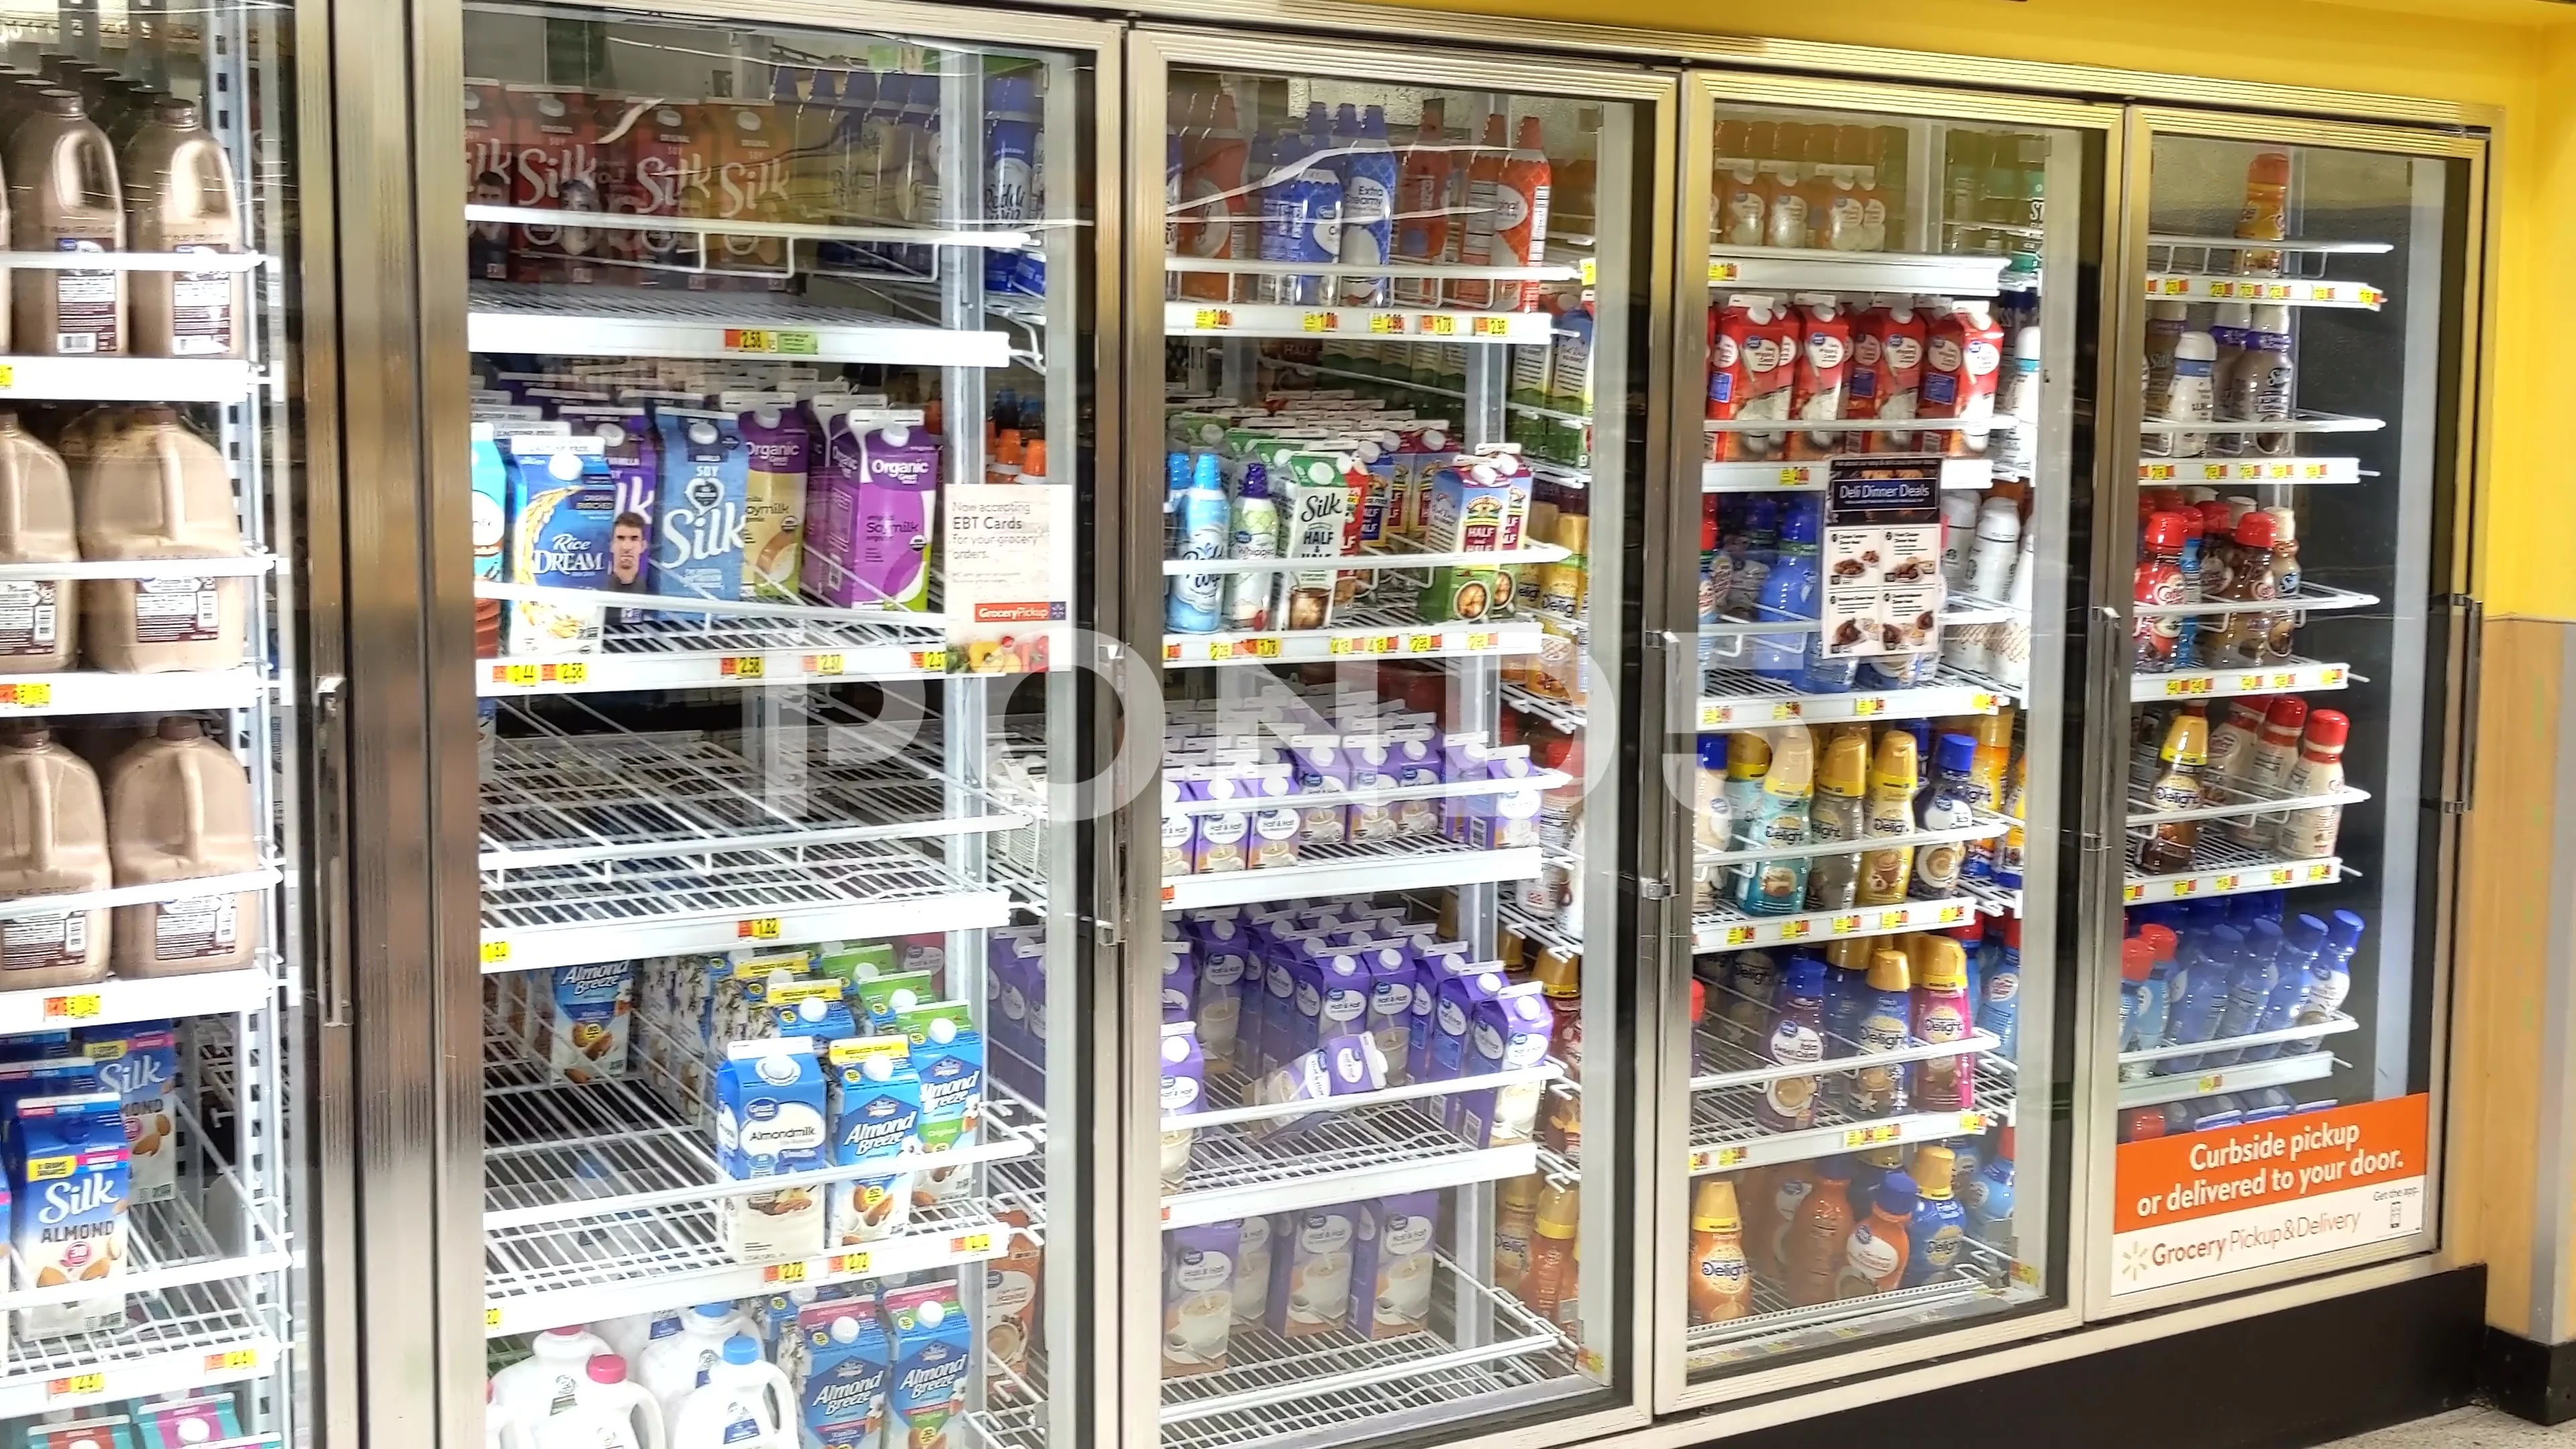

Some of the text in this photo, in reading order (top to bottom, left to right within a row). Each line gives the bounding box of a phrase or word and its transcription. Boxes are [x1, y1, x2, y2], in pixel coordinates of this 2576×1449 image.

[519, 144, 597, 206] Silk
[636, 154, 710, 214] Silk
[719, 158, 790, 218] Silk
[696, 466, 719, 476] SOY
[871, 458, 929, 478] Organic
[1839, 483, 1930, 498] Deli Dinner Deals
[745, 504, 790, 516] oymilk
[1301, 492, 1342, 523] Silk
[661, 502, 747, 569] Silk
[953, 516, 1023, 530] EBT Cards
[1467, 527, 1495, 537] HALF
[551, 533, 592, 553] Rice
[1303, 531, 1334, 545] HALF
[532, 549, 603, 576] DREAM
[561, 959, 631, 986] Almond
[574, 974, 620, 996] Breeze
[97, 1054, 168, 1095] Silk
[918, 1069, 981, 1104] Almond
[922, 1089, 969, 1115] Breeze
[749, 1125, 817, 1142] Almondmilk
[843, 1110, 918, 1146] Almond
[855, 1130, 905, 1156] Breeze
[2189, 1122, 2361, 1171] Curbside pickup
[2137, 1148, 2404, 1218] or delivered to your door.
[38, 1171, 121, 1225] Silk
[40, 1219, 115, 1244] ALMOND
[2151, 1234, 2227, 1267] Grocery
[2229, 1224, 2282, 1252] Pickup
[2298, 1210, 2361, 1238] Delivery
[899, 1352, 968, 1391] Almond
[812, 1370, 885, 1407] Almond
[910, 1373, 956, 1400] Breeze
[824, 1391, 871, 1416] Breeze
